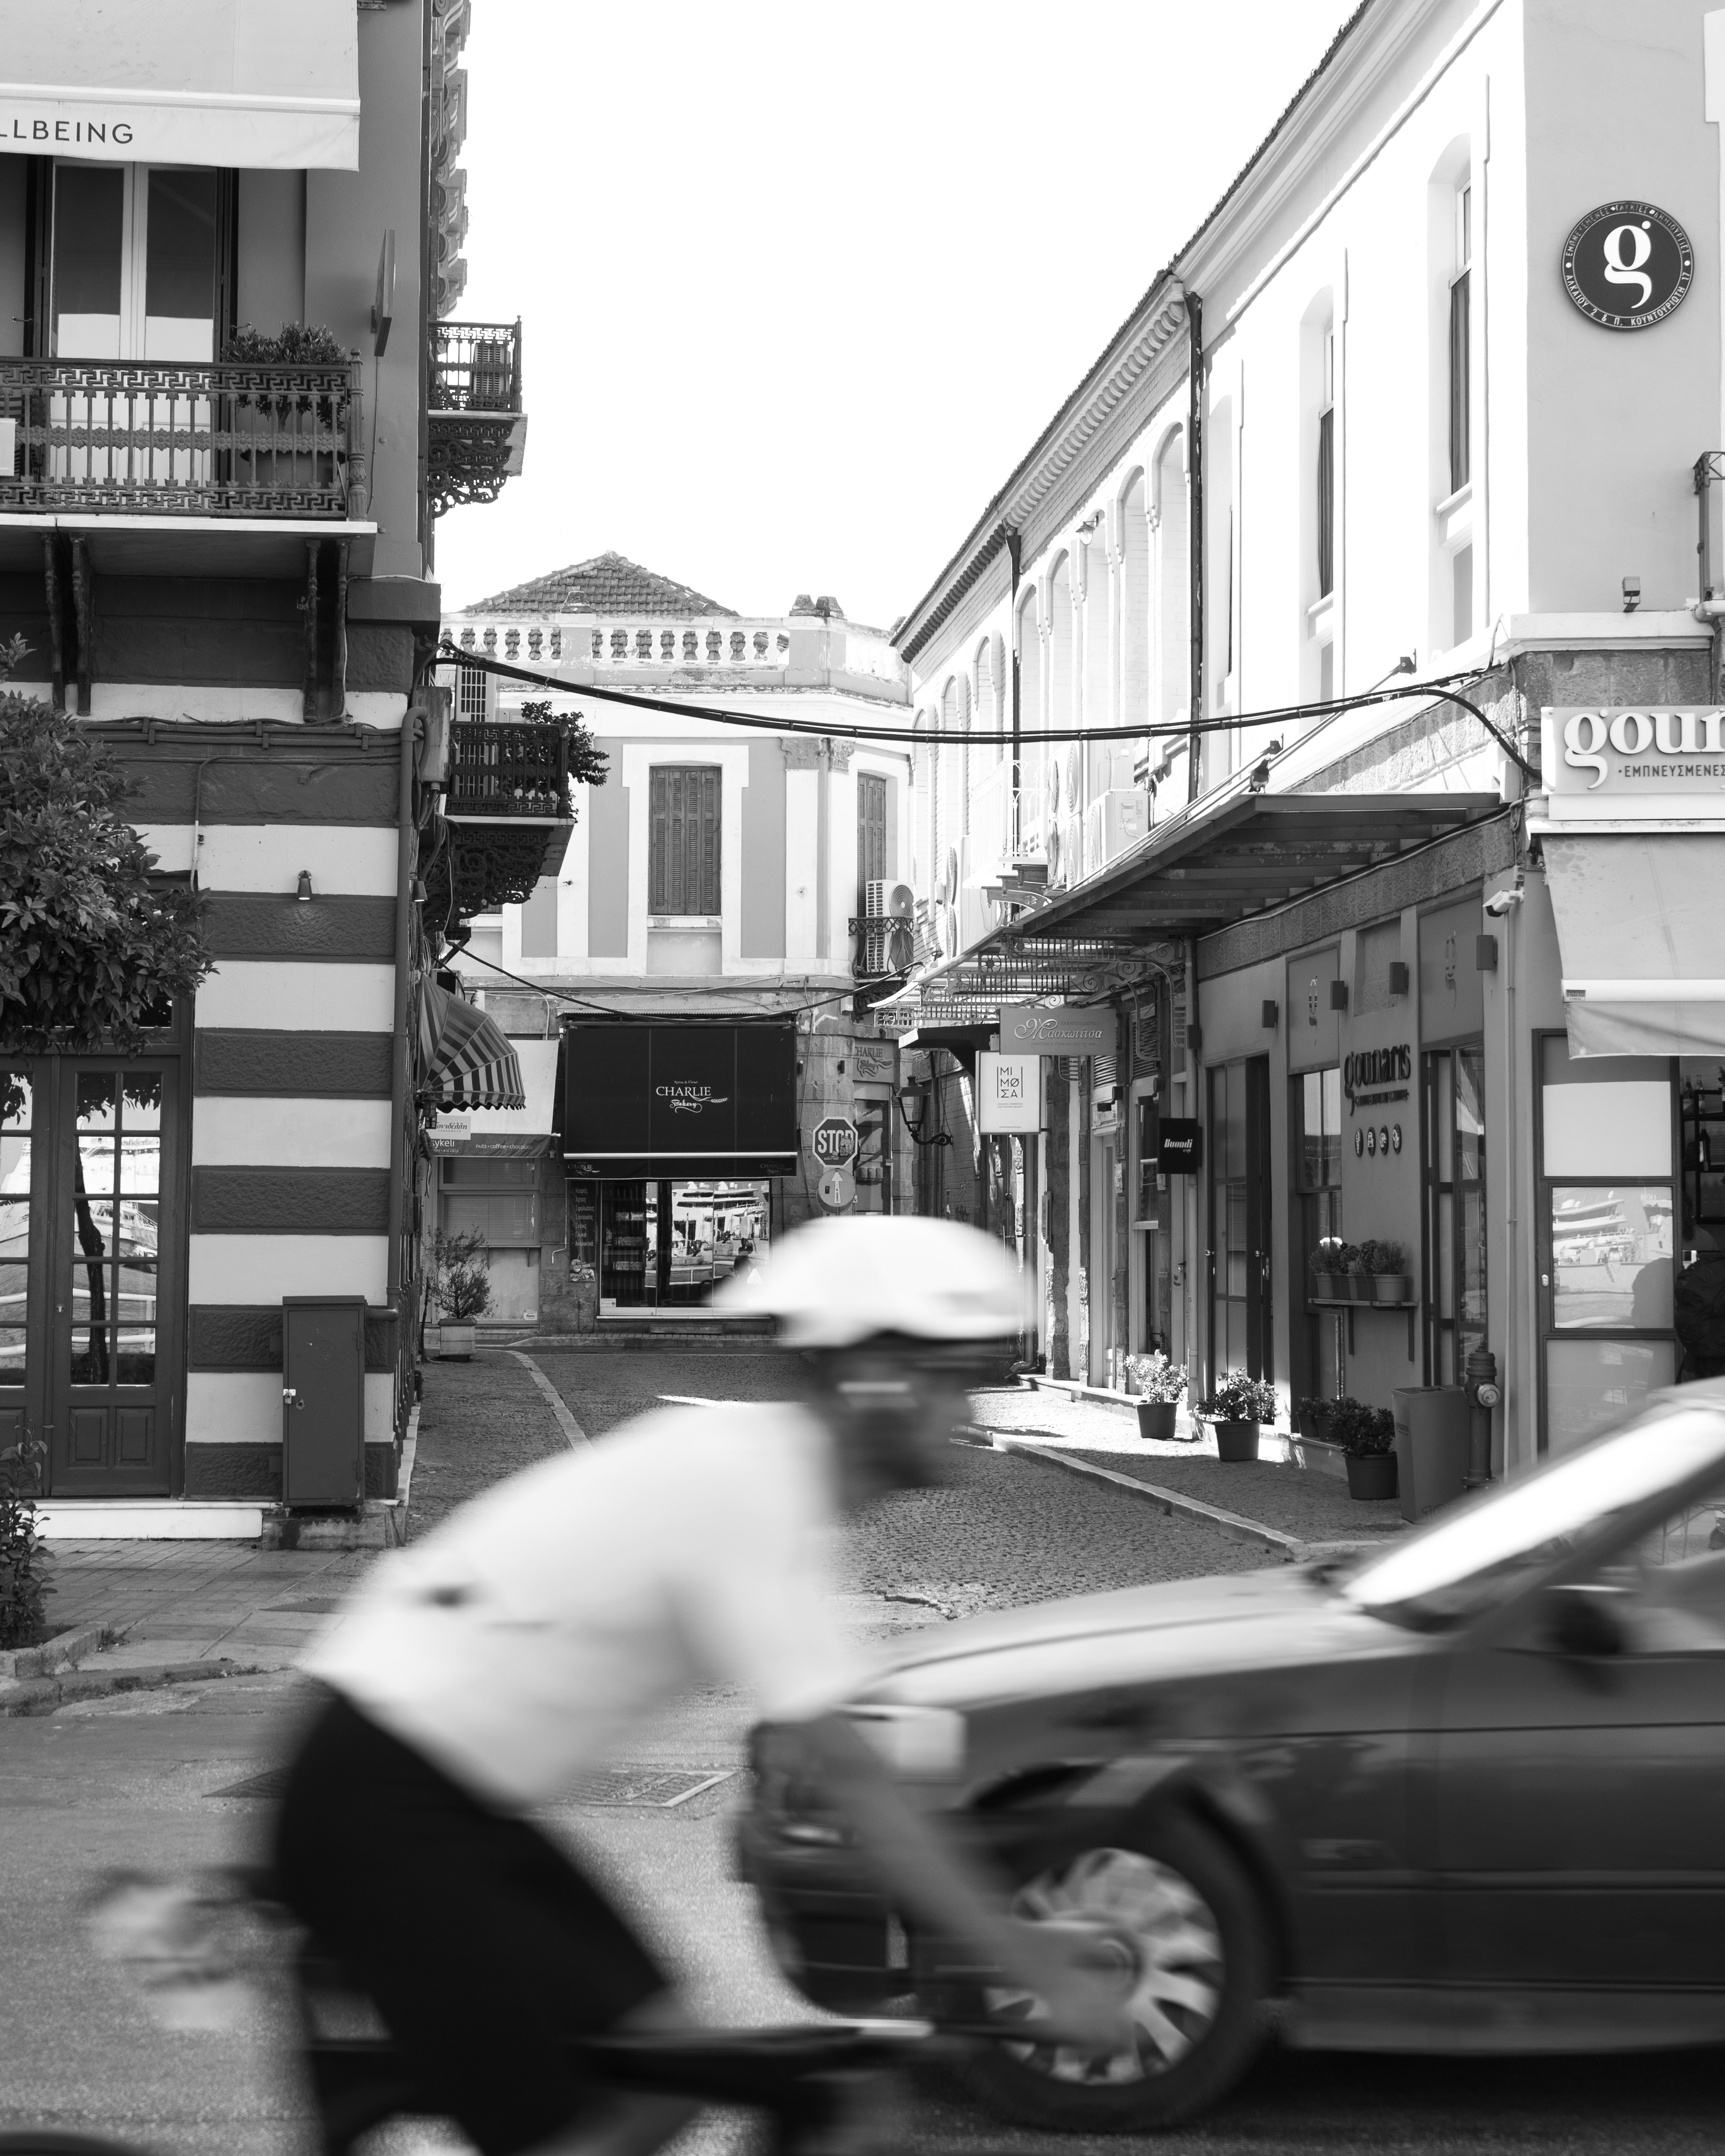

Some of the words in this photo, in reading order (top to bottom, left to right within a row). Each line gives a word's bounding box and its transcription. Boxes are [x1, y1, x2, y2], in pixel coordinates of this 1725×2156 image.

[1653, 212, 1690, 254] ΔΗΜΙΟΥΡΓΙΕΣ
[1566, 275, 1590, 309] ΑΛΚΑΙΟΥ
[1590, 308, 1597, 316] 2
[1631, 286, 1686, 326] ΚΟΥΝΤΟΥΡΙΩΤΗ
[1682, 272, 1691, 281] 17
[1014, 1018, 1102, 1040] Μασκωτίτσα
[855, 1046, 883, 1058] HARLIE
[1001, 1067, 1012, 1076] MI
[1344, 1043, 1411, 1117] gounaris
[656, 1086, 711, 1097] CHARLIE
[670, 1099, 700, 1111] Bakery
[1164, 1138, 1193, 1148] Buondi
